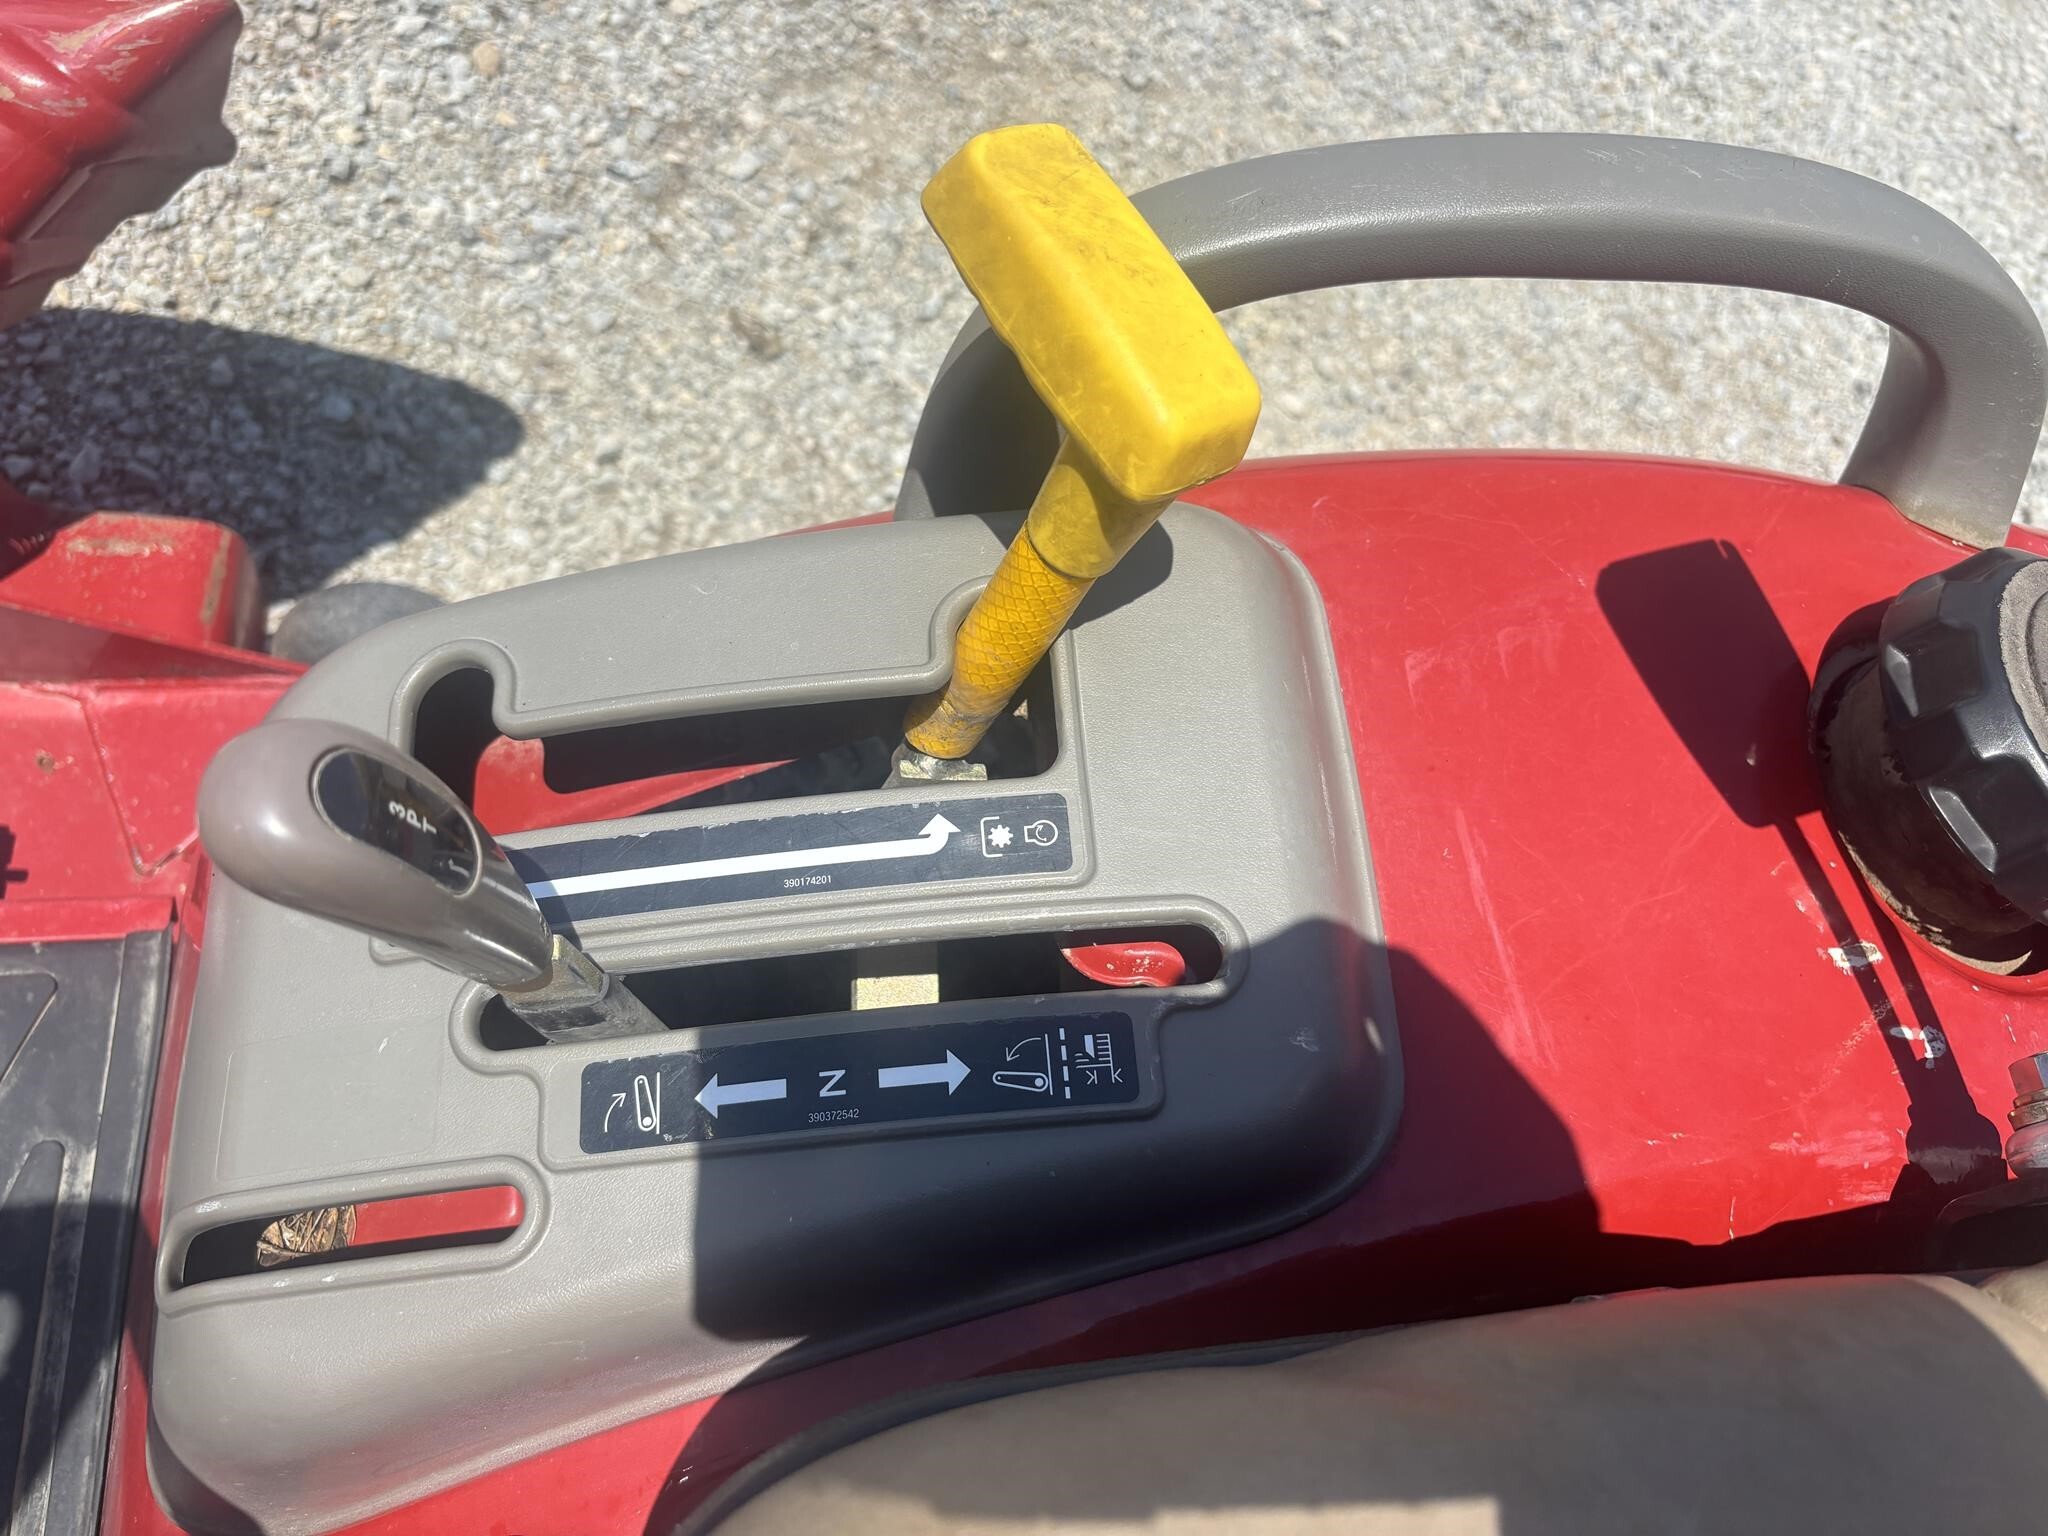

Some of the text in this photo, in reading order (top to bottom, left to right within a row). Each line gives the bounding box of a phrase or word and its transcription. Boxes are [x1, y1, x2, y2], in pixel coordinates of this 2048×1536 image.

[388, 800, 437, 834] 3PT
[783, 874, 832, 888] 390174201
[808, 1108, 860, 1123] 390372542
